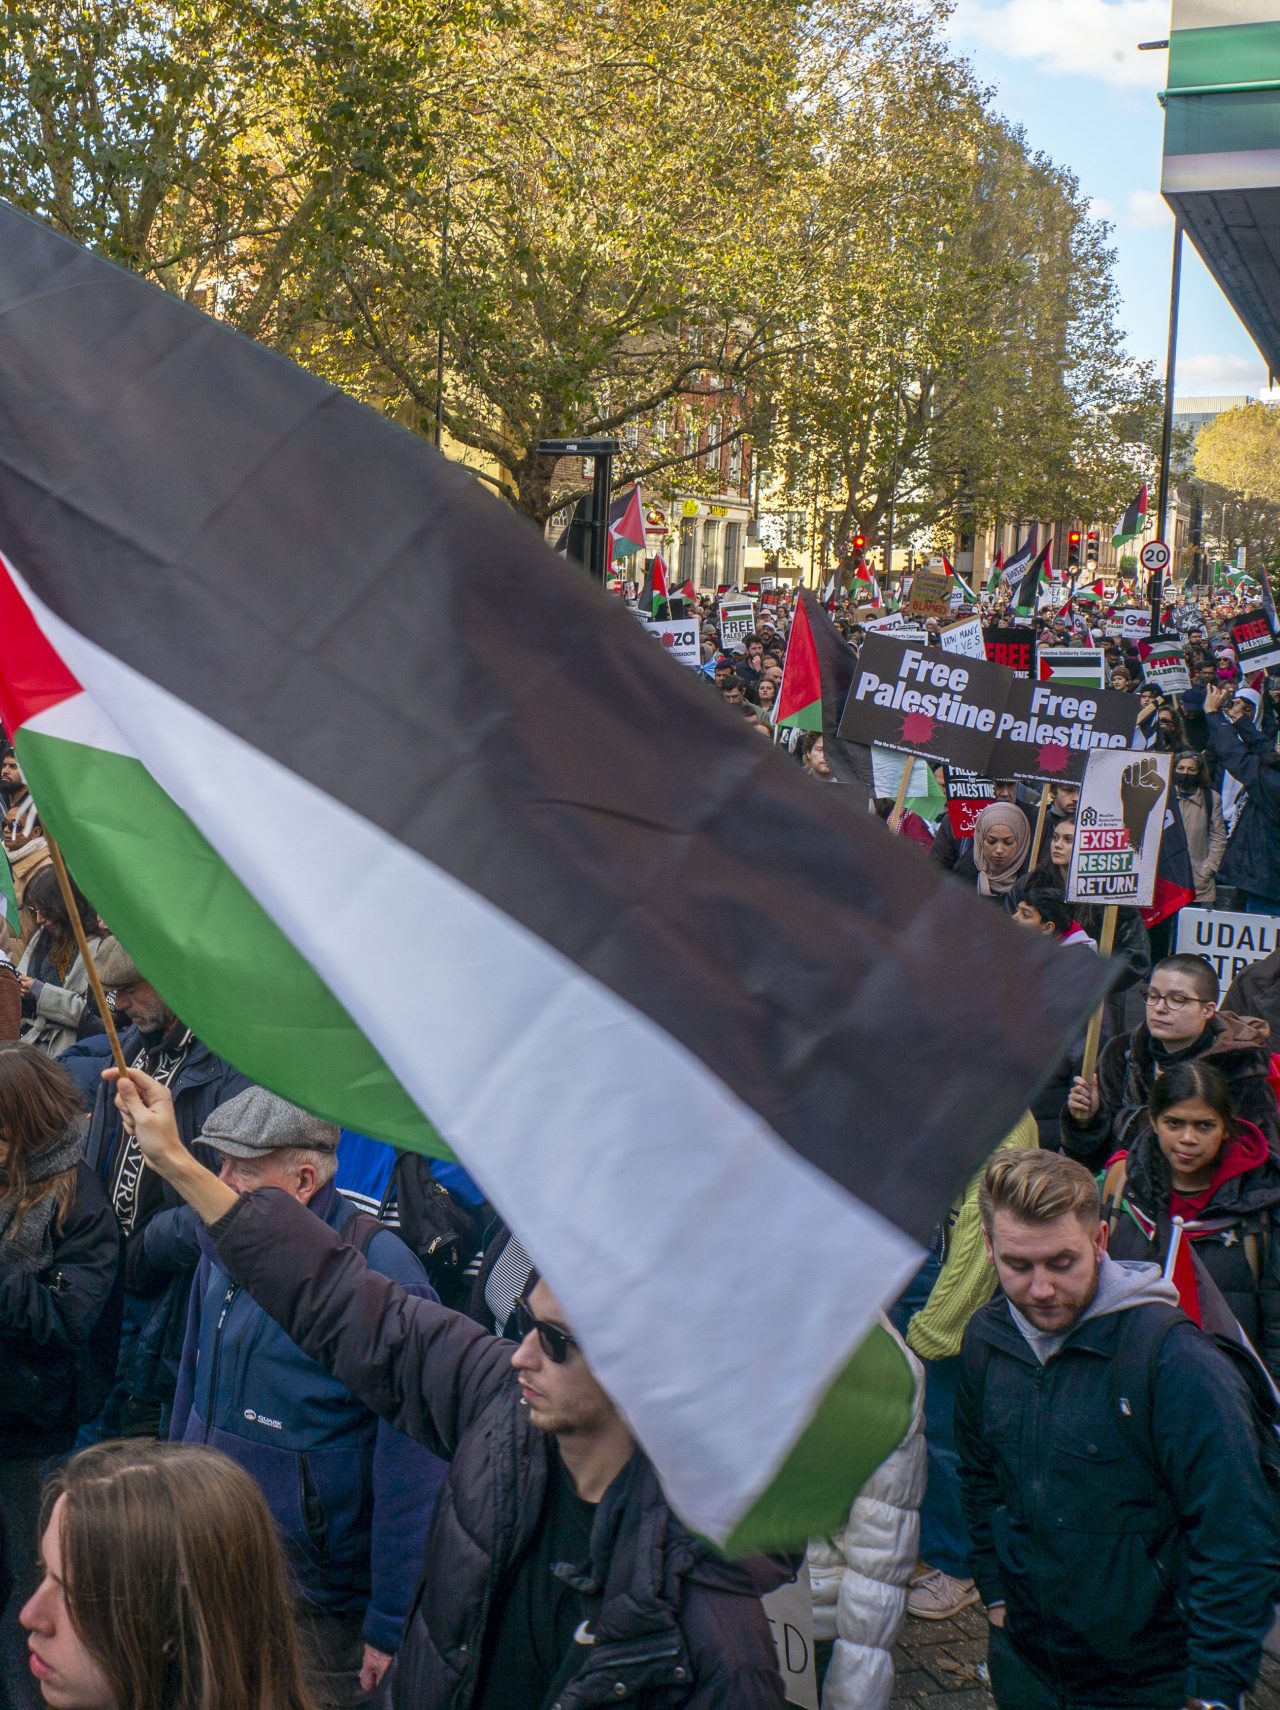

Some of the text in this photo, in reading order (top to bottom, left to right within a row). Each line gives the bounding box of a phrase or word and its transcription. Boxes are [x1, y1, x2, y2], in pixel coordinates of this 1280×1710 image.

[1144, 549, 1167, 563] 20
[912, 600, 947, 615] BLAMED
[722, 621, 754, 634] FREE
[944, 624, 979, 647] HOW MANY
[1232, 618, 1268, 643] FREE
[1237, 634, 1273, 651] PALESTINE
[984, 643, 1030, 670] FREE
[899, 649, 969, 691] Free
[855, 671, 996, 732] Palestine
[1030, 687, 1097, 721] Free
[995, 713, 1127, 750] Palestine
[949, 782, 996, 798] PALESTINE
[1080, 831, 1128, 849] EXIST.
[1078, 854, 1132, 872] RESIST.
[1077, 875, 1137, 896] RETURN.
[258, 1415, 282, 1426] QUARK
